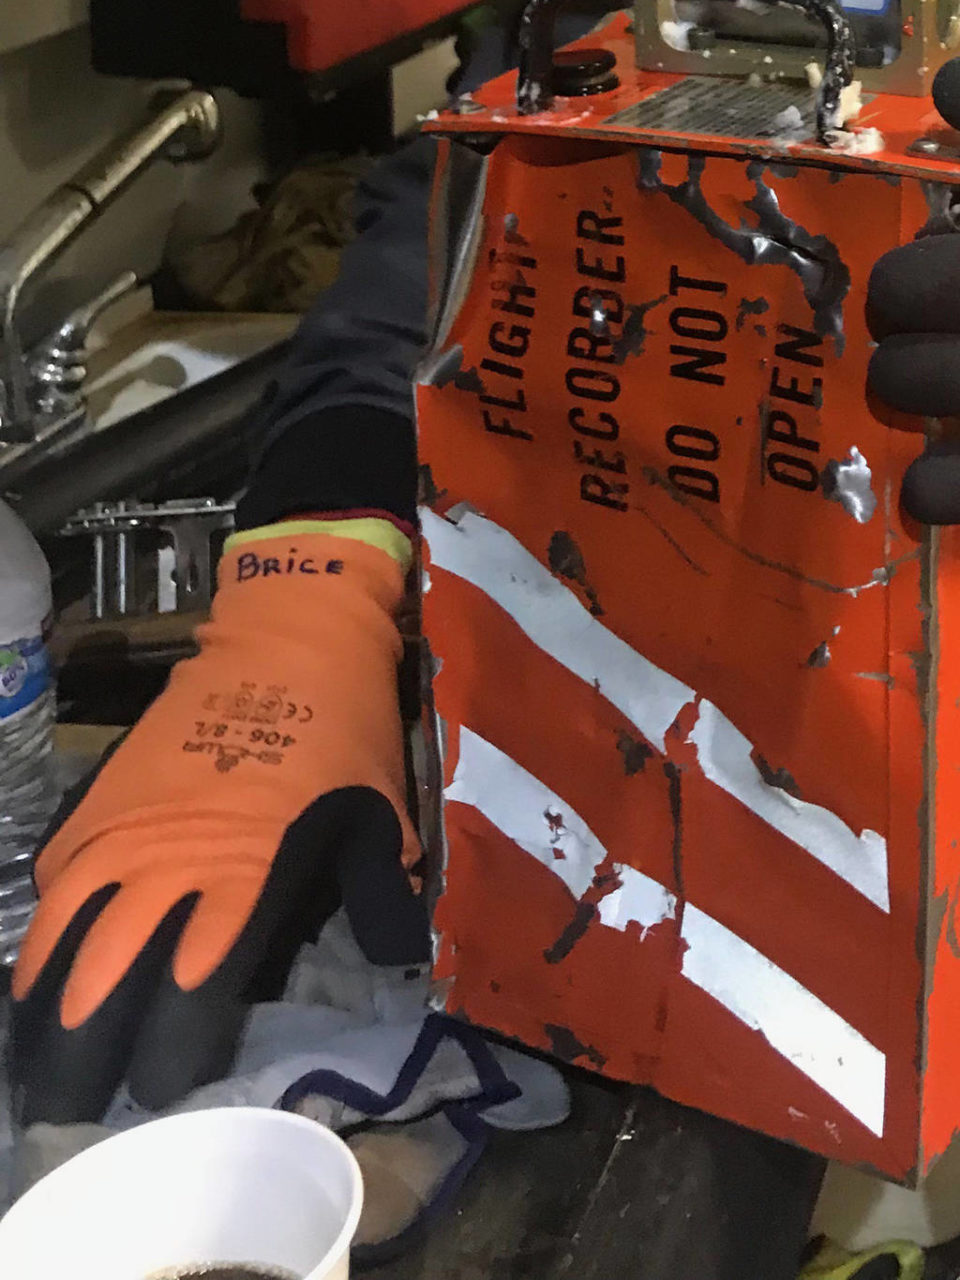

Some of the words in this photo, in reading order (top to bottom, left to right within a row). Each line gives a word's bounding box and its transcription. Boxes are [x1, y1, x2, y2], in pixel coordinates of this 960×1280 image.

[480, 247, 538, 442] FLIGHT
[564, 208, 630, 512] RECORDER
[668, 264, 728, 387] NOT
[766, 323, 825, 494] OPEN
[665, 424, 722, 503] DO
